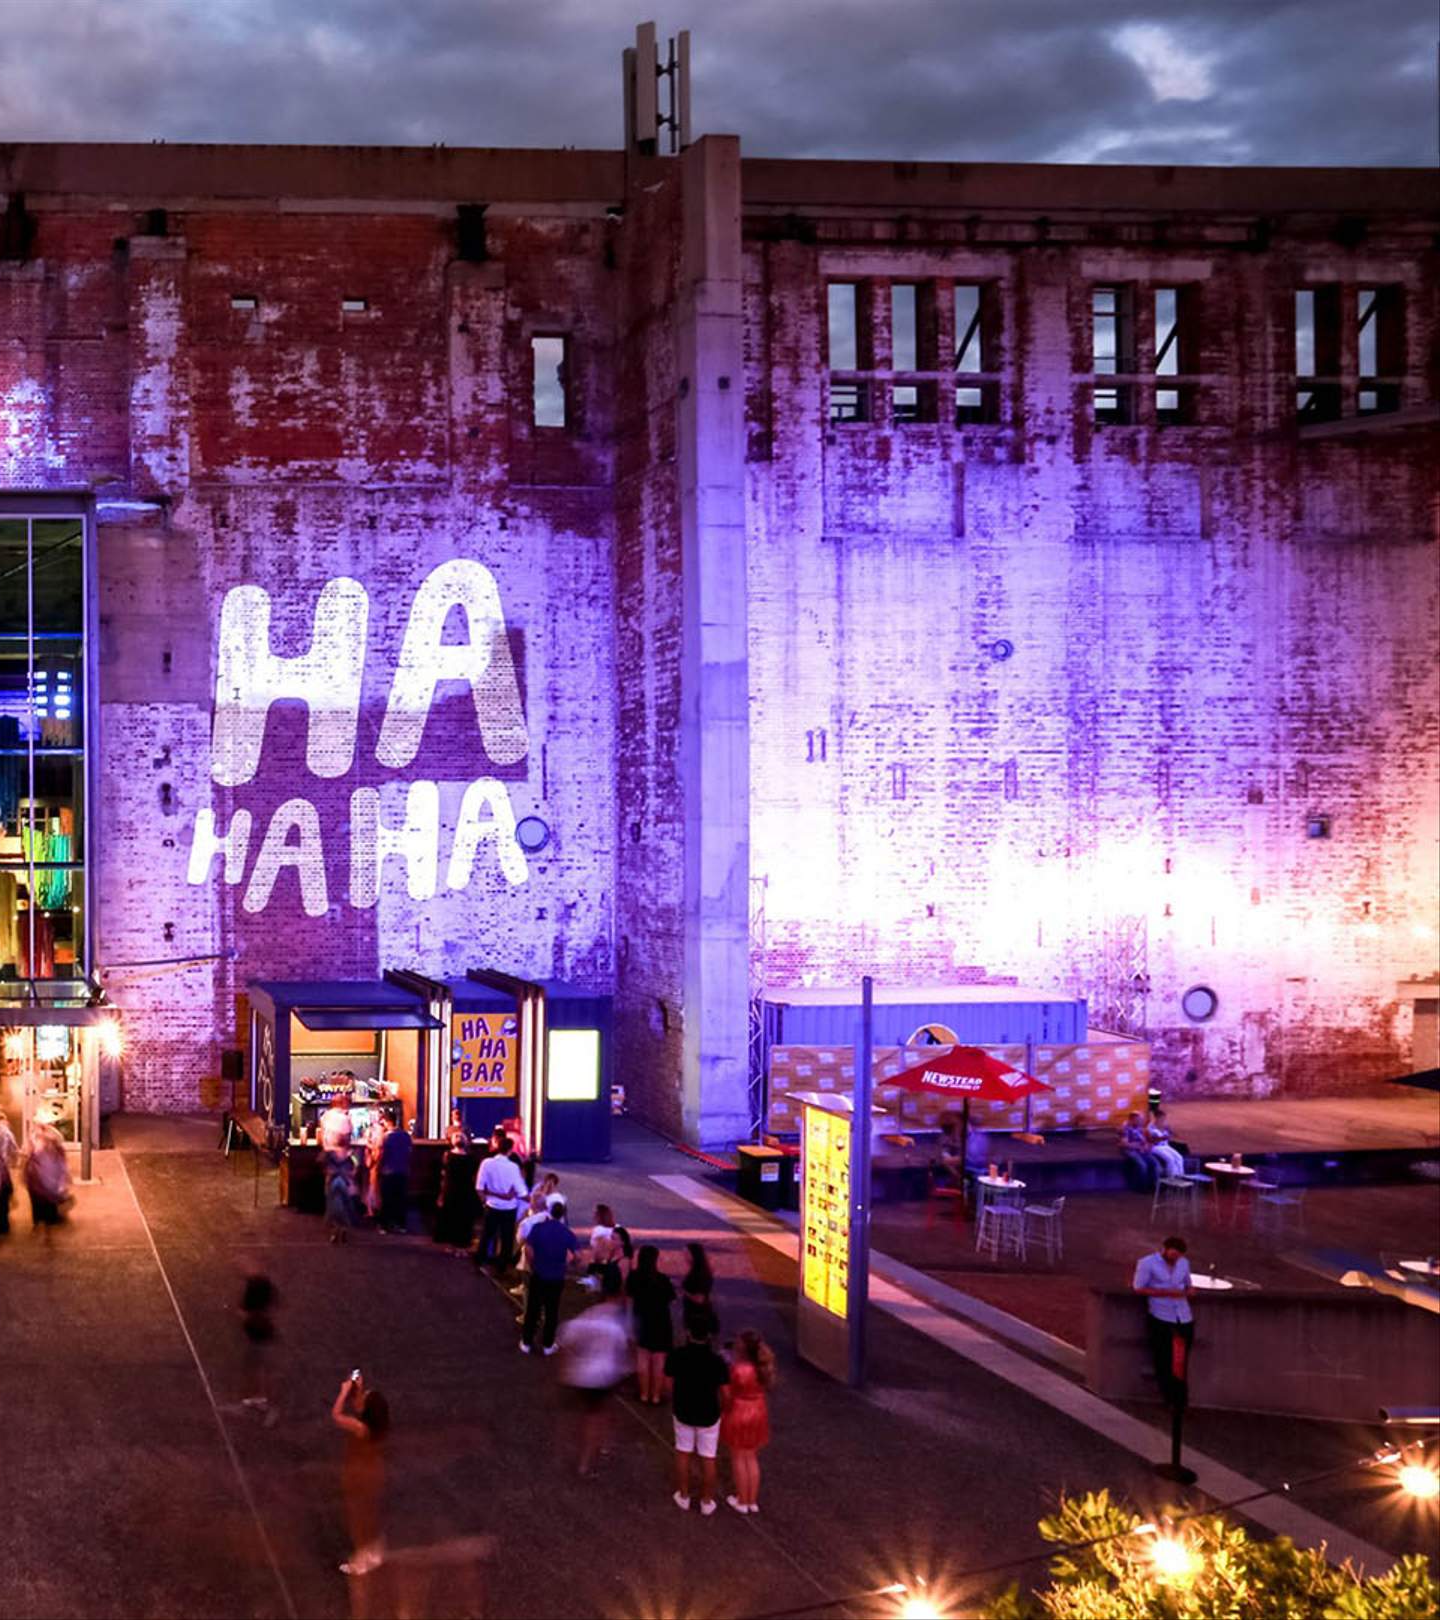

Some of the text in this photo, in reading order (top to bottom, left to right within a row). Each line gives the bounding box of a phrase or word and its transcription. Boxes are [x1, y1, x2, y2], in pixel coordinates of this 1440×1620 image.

[211, 558, 530, 787] HA
[461, 1017, 490, 1042] HA
[478, 1037, 507, 1059] HA
[461, 1061, 505, 1083] BAR
[921, 1070, 983, 1086] NEWSTEAD
